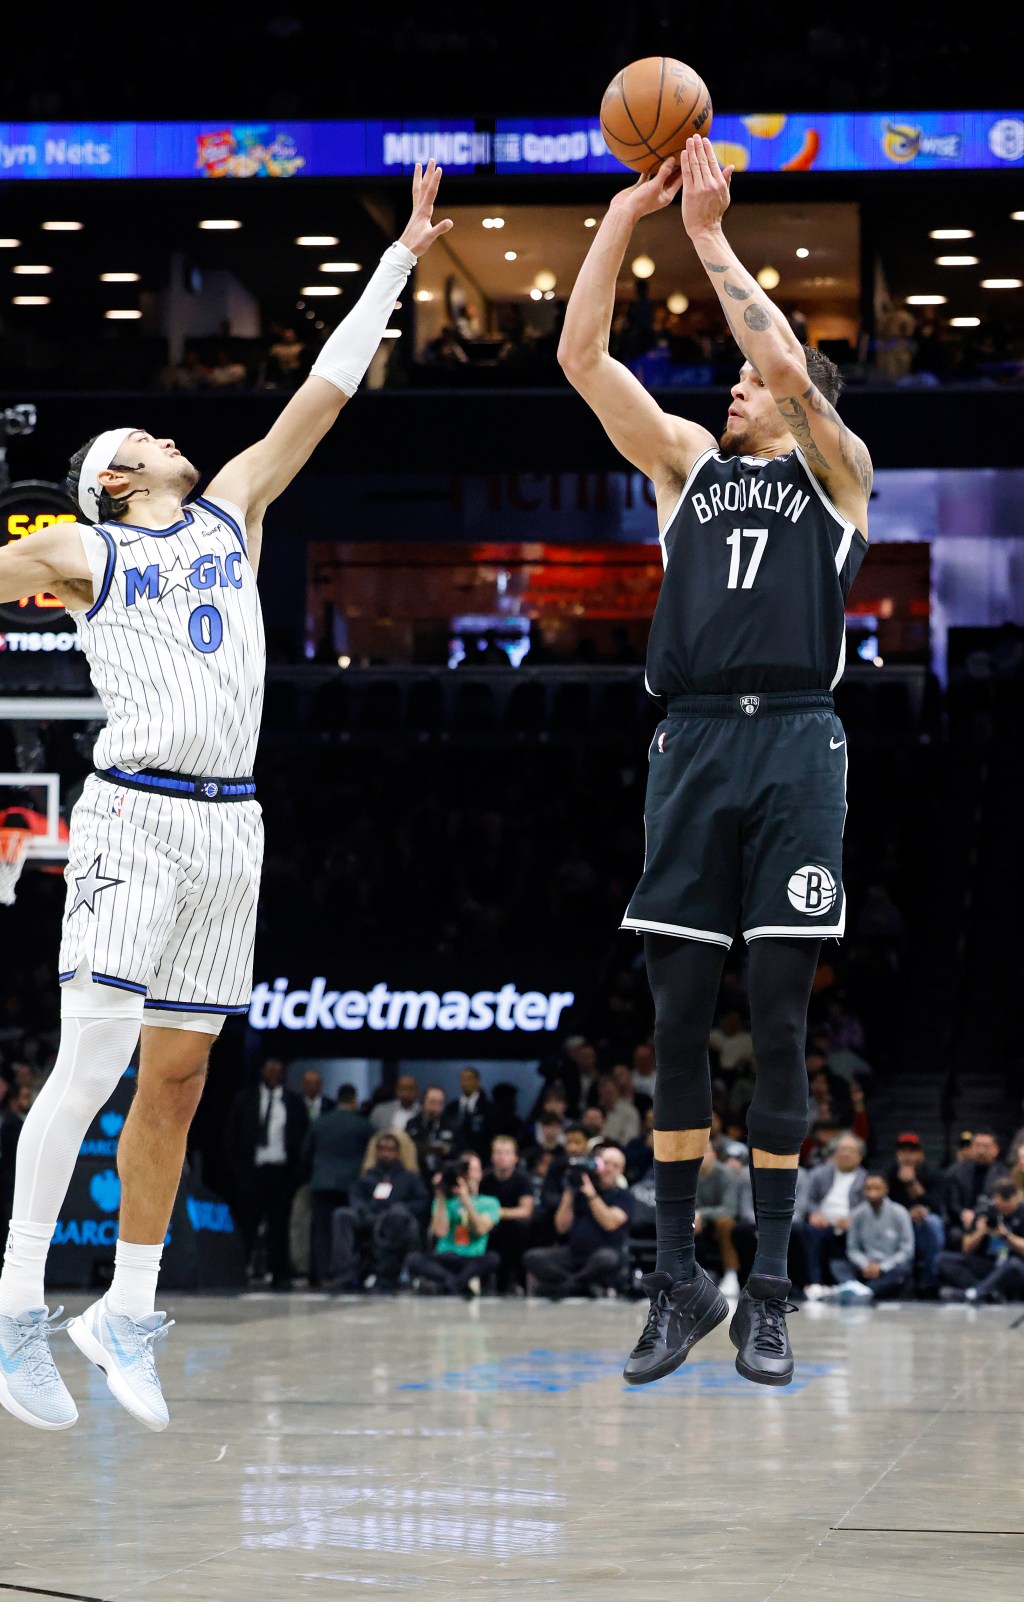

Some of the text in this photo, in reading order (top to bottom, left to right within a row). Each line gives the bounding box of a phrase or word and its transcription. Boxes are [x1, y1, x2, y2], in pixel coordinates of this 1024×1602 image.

[0, 138, 111, 168] yn Nets
[522, 132, 588, 164] GOOD
[691, 477, 811, 525] BROOKLYN
[726, 528, 769, 589] 17
[188, 604, 223, 654] 0
[741, 697, 758, 706] NETS
[805, 871, 822, 908] B
[249, 976, 575, 1031] ticketmaster
